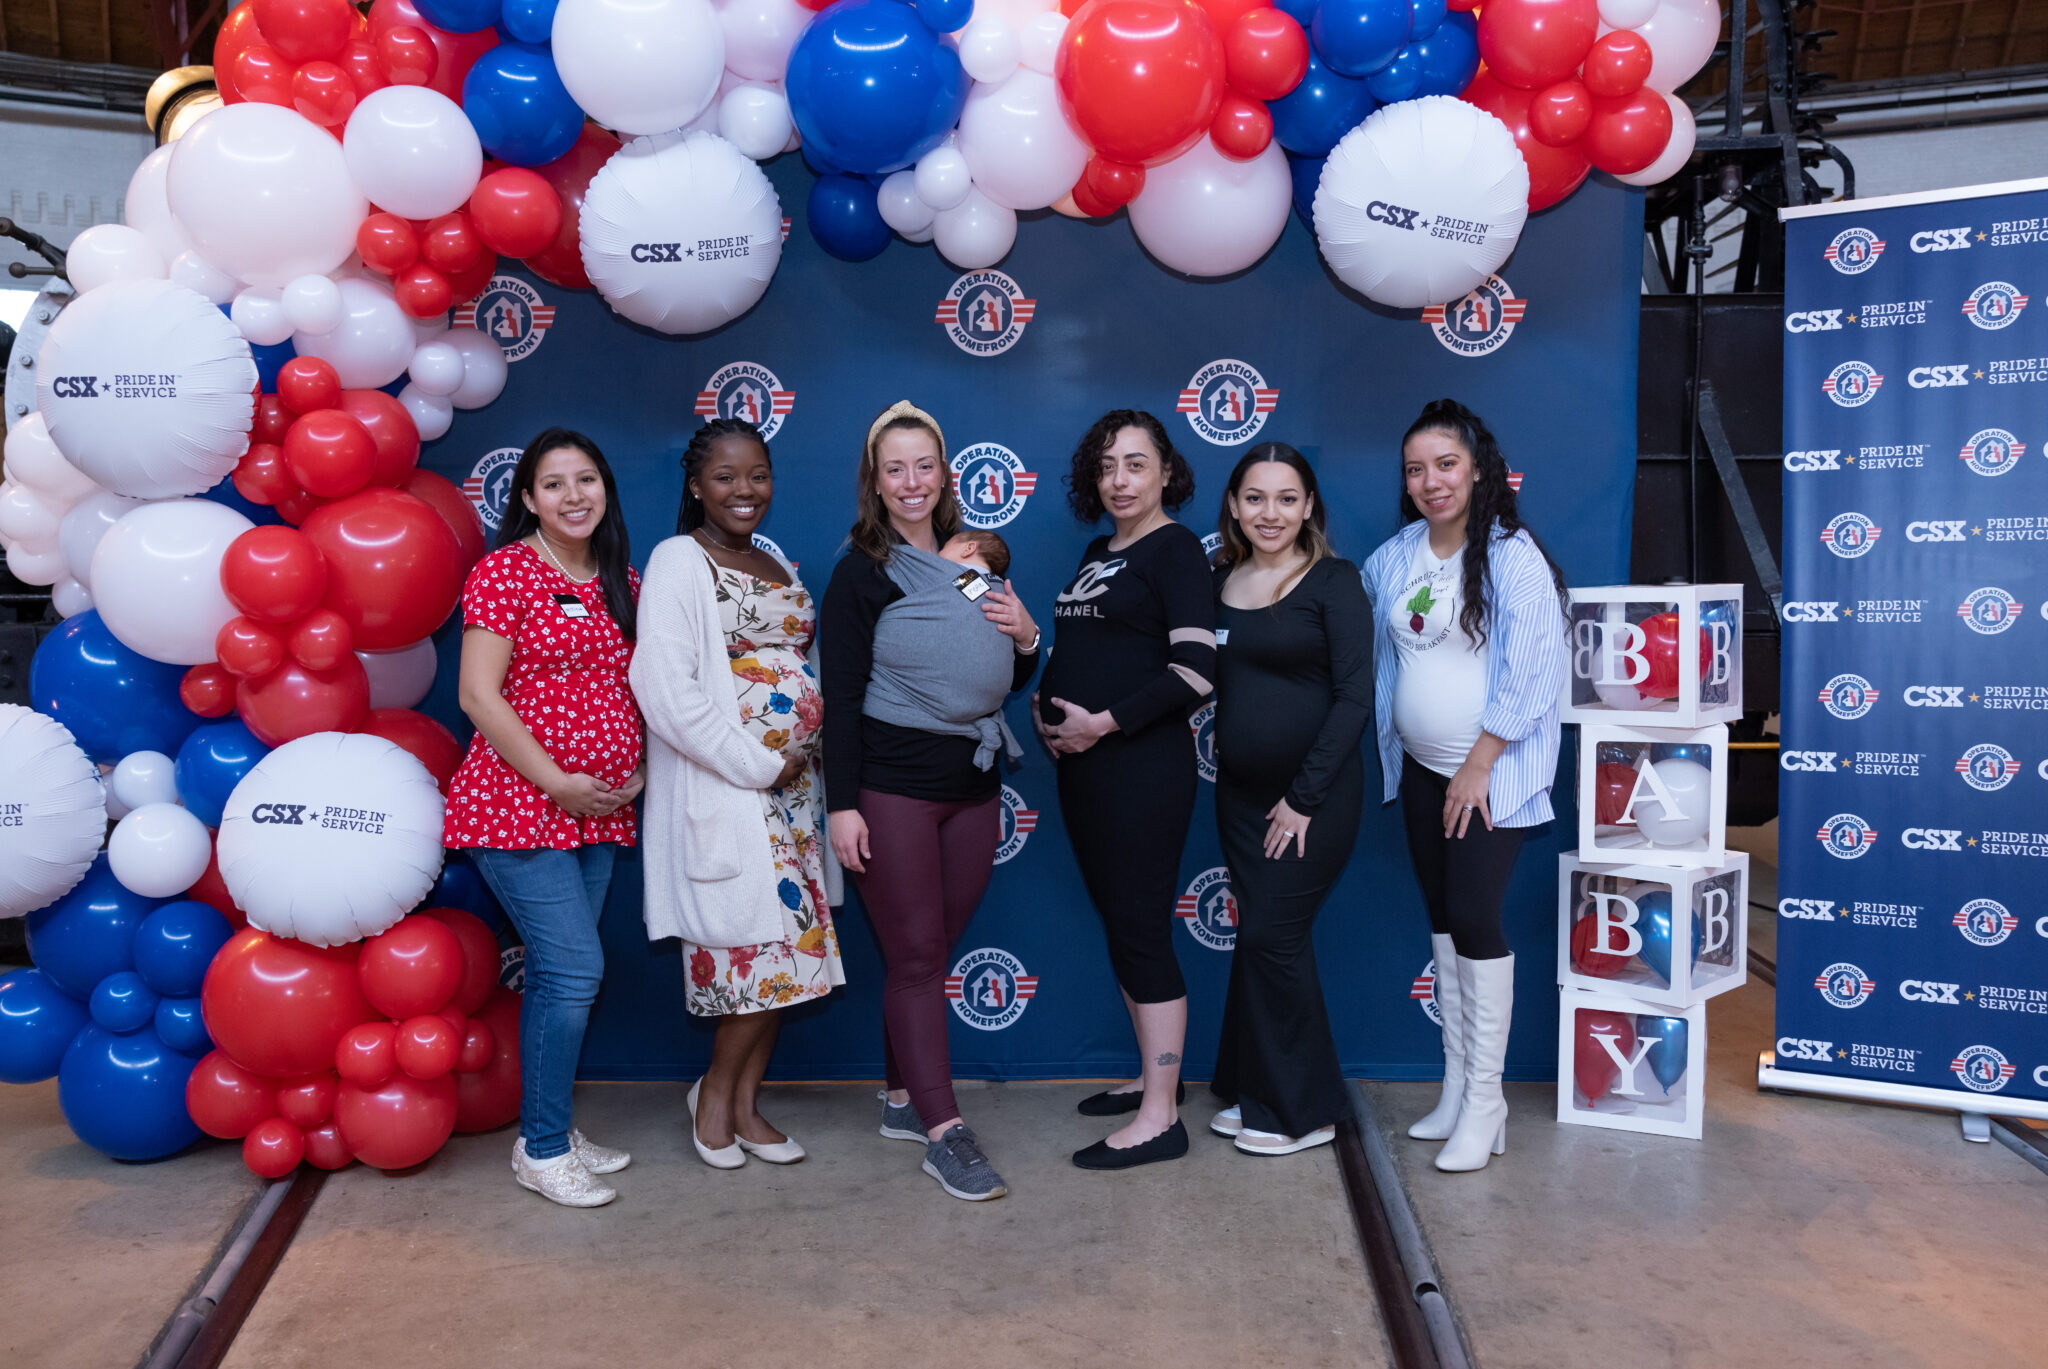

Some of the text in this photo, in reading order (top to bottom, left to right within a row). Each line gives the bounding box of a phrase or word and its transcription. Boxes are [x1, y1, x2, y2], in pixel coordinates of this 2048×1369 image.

[1366, 200, 1419, 231] CSX
[1435, 215, 1474, 230] PRIDE
[1992, 218, 2040, 234] PRIDE
[1430, 227, 1486, 245] SERVICE
[1836, 230, 1873, 244] OPERATION
[1910, 227, 1971, 253] CSX
[1990, 230, 2048, 246] SERVIC
[698, 238, 734, 251] PRIDE
[631, 243, 682, 263] CSX
[698, 247, 750, 261] SERVICE
[1834, 256, 1875, 272] HOMEFRONT
[471, 280, 536, 304] RATION
[954, 273, 1017, 297] OPERATION
[1974, 284, 2014, 298] OPERATION
[1861, 302, 1906, 316] PRIDE
[1785, 309, 1842, 333] CSX
[1860, 313, 1926, 328] SERVICE
[1972, 312, 2017, 327] HOMEFRONT
[504, 332, 538, 358] FRONT
[952, 326, 1018, 352] HOMEFRONT
[1438, 326, 1508, 353] HOMEFRONT
[1834, 364, 1871, 377] OPERATION
[1989, 358, 2037, 372] PRIDE
[115, 375, 156, 385] PRIDE
[712, 366, 776, 389] OPERATION
[1195, 364, 1260, 387] OPERATION
[1908, 364, 1969, 389] CSX
[1988, 370, 2048, 384] SERVIC
[53, 376, 98, 398] CSX
[115, 387, 177, 398] SERVICE
[1832, 390, 1872, 405] HOMEFRONT
[1193, 416, 1261, 442] HOMEFRONT
[1972, 431, 2012, 445] OPERATION
[956, 446, 1018, 470] OPERATION
[1860, 445, 1904, 457] PRIDE
[478, 452, 522, 475] OPERAT
[1784, 450, 1840, 472] CSX
[1859, 457, 1924, 470] SERVICE
[1970, 459, 2014, 473] HOMEFRONT
[1832, 514, 1869, 527] OPERATION
[1987, 517, 2034, 529] PRIDE
[1905, 520, 1966, 542] CSX
[1986, 530, 2048, 542] SERVIC
[1830, 542, 1871, 557] HOMEFRONT
[1970, 589, 2009, 602] OPERATION
[1055, 605, 1105, 618] HANEL
[1782, 601, 1839, 622] CSX
[1857, 600, 1901, 611] PRIDE
[1857, 612, 1921, 623] SERVICE
[1968, 618, 2011, 632] HOMEFRONT
[1415, 626, 1451, 651] BREAKFAST
[1594, 622, 1650, 685] B
[1709, 621, 1731, 685] B
[1830, 676, 1867, 689] OPERATION
[1903, 685, 1964, 707] CSX
[1984, 686, 2031, 697] PRIDE
[1828, 703, 1868, 718] HOMEFRONT
[1855, 752, 1900, 763] PRIDE
[1967, 746, 2008, 759] OPERATION
[1780, 750, 1837, 772] CSX
[1855, 764, 1919, 776] SERVICE
[1965, 774, 2008, 788] HOMEFRONT
[1615, 759, 1690, 824] A
[252, 803, 307, 825] CSX
[324, 806, 368, 820] PRIDE
[321, 818, 384, 835] SERVICE
[1828, 816, 1865, 829] OPERATION
[1901, 827, 1962, 851] CSX
[1981, 831, 2029, 844] PRIDE
[1826, 842, 1866, 856] HOMEFRONT
[1193, 871, 1230, 893] OPERA
[1779, 897, 1835, 921] CSX
[1853, 902, 1898, 915] PRIDE
[1965, 901, 2004, 914] OPERATION
[1589, 891, 1642, 956] B
[1702, 887, 1729, 955] B
[1853, 914, 1917, 928] SERVICE
[1191, 921, 1236, 946] HOMEFR
[1963, 928, 2006, 944] HOMEFRONT
[959, 952, 1020, 974] OPERATION
[1826, 965, 1863, 979] OPERATION
[1824, 991, 1864, 1006] HOMEFRONT
[1899, 979, 1960, 1005] CSX
[1980, 985, 2027, 1000] PRIDE
[1978, 998, 2048, 1014] SERVICE
[957, 1002, 1022, 1027] HOMEFRONT
[1776, 1037, 1833, 1062] CSX
[1851, 1043, 1895, 1058] PRIDE
[1962, 1048, 2002, 1061] OPERATION
[1589, 1033, 1663, 1096] Y
[1850, 1056, 1915, 1072] SERVICE
[1961, 1074, 2004, 1090] HOMEFRONT
